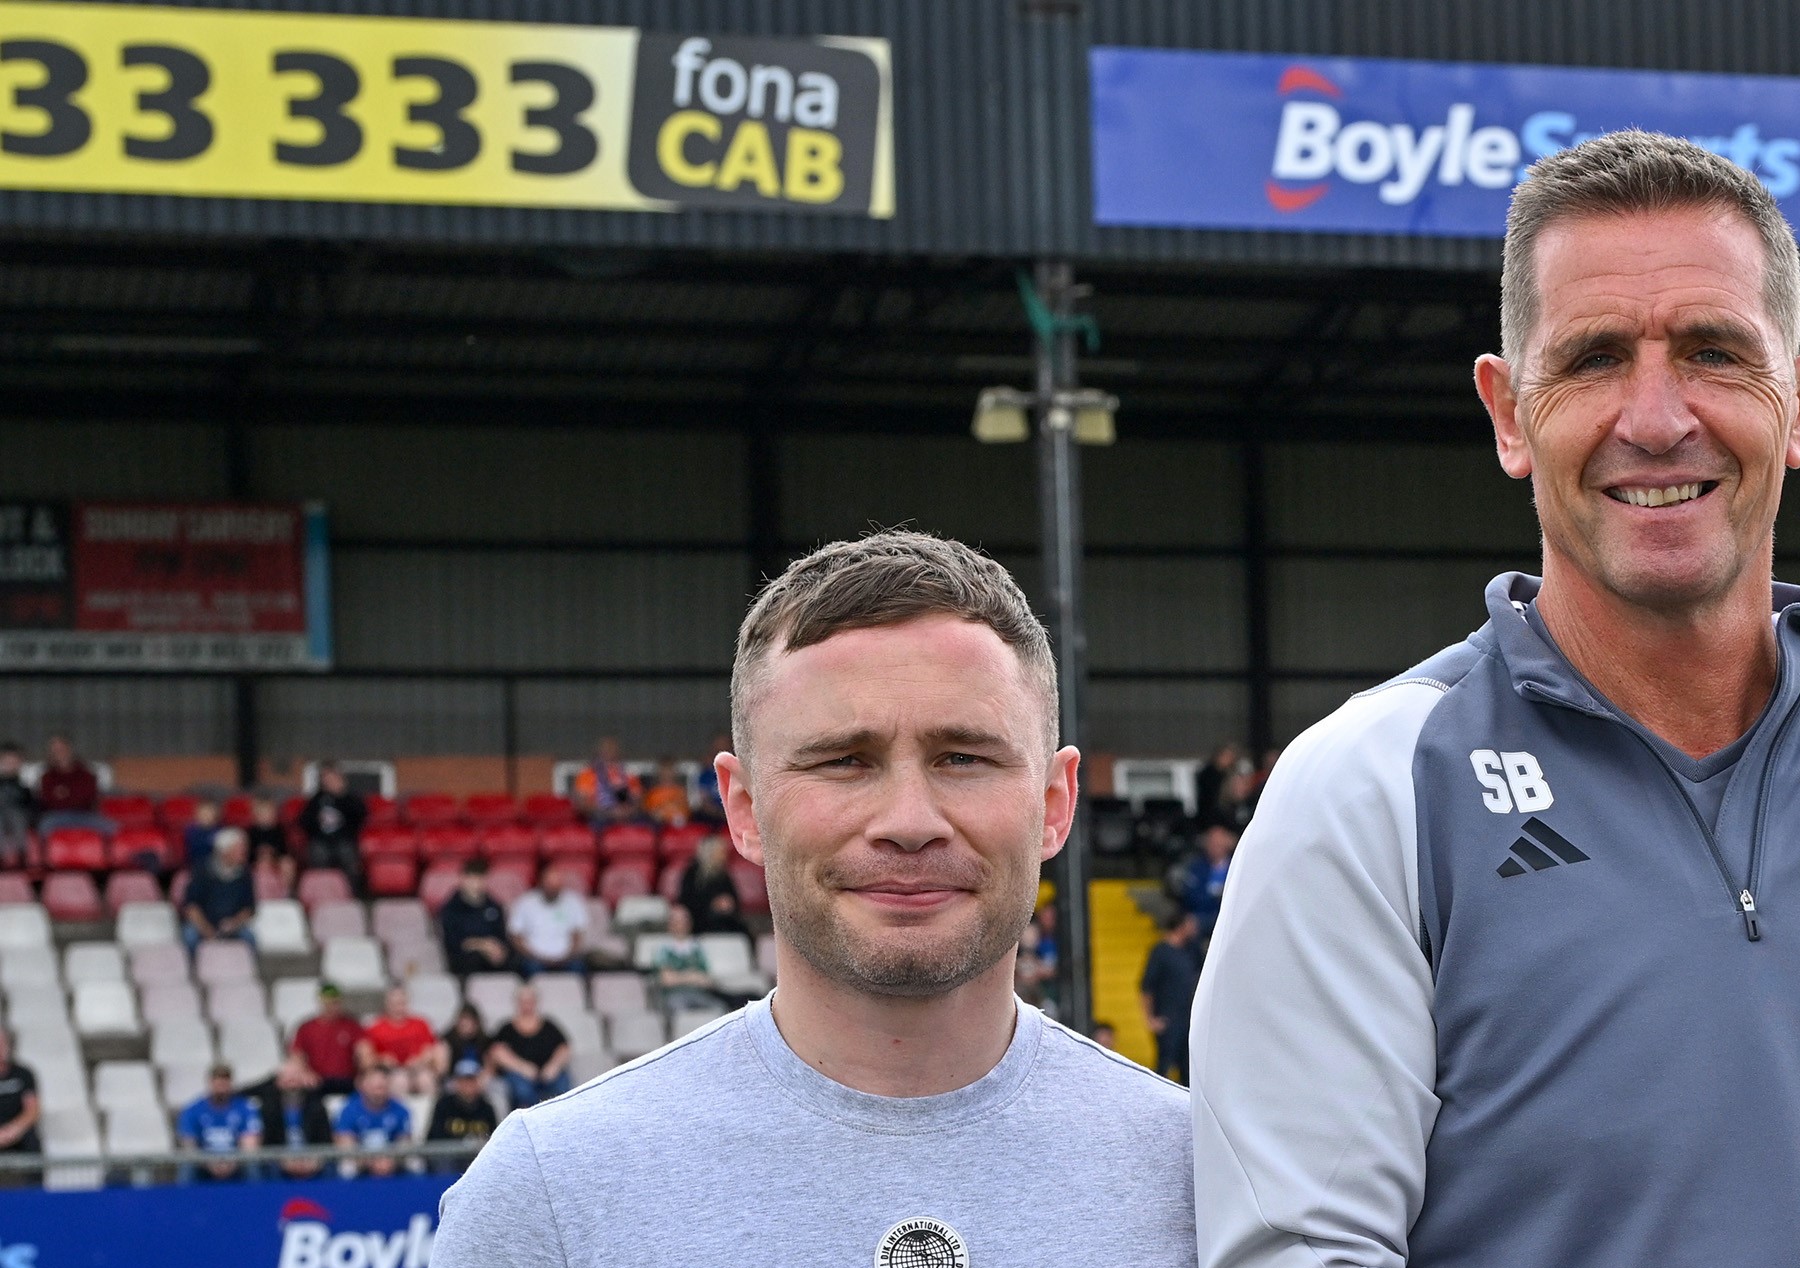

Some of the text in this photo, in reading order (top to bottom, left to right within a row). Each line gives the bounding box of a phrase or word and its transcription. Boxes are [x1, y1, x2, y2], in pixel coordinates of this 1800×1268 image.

[0, 36, 603, 178] 33 333
[672, 38, 840, 129] fona
[655, 111, 846, 204] CAB
[1469, 749, 1555, 814] SB
[887, 1221, 948, 1244] INTERNATIONAL
[947, 1235, 960, 1251] LTD
